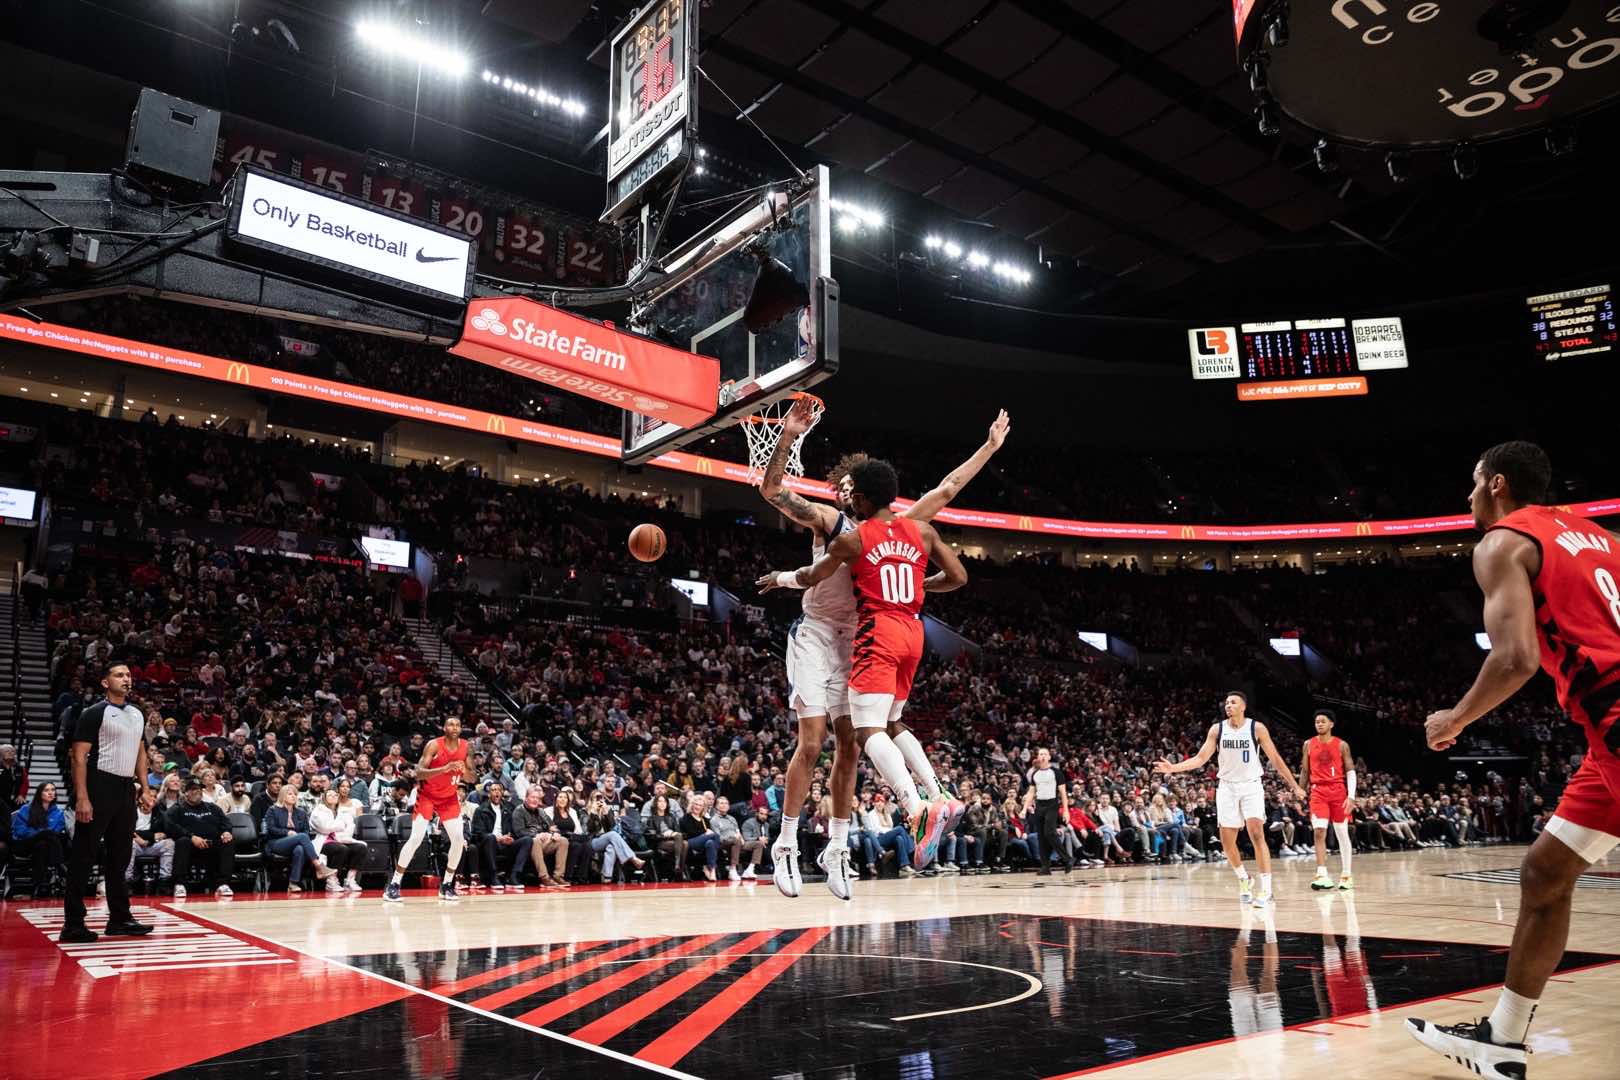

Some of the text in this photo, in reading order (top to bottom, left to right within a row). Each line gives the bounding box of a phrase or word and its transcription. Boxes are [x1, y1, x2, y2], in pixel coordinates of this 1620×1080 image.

[631, 92, 682, 149] TISSOT
[311, 166, 350, 194] 15
[381, 187, 415, 215] 13
[253, 197, 409, 259] Only Basketball
[445, 205, 484, 237] 20
[510, 224, 546, 256] 32
[570, 241, 605, 273] 22
[1364, 325, 1401, 335] BARREL
[1549, 314, 1595, 328] REBOUNDS
[1599, 311, 1614, 321] 32
[1554, 325, 1594, 338] STEALS
[45, 330, 81, 345] Chicken
[81, 338, 129, 354] McNuggets
[130, 348, 149, 359] with
[1356, 334, 1390, 344] BREWING
[1560, 337, 1592, 348] TOTAL
[1197, 357, 1233, 366] LORENTZ
[1358, 350, 1405, 361] DRINK BEER
[1199, 364, 1235, 374] BRUUN
[271, 376, 283, 385] 100
[284, 379, 307, 390] Points
[343, 391, 371, 403] Chicken
[865, 541, 923, 565] HENDERSON
[879, 562, 915, 605] 00
[1594, 567, 1620, 629] 8
[1222, 739, 1250, 749] DALLAS
[1242, 750, 1250, 763] 0
[1329, 766, 1336, 777] 1
